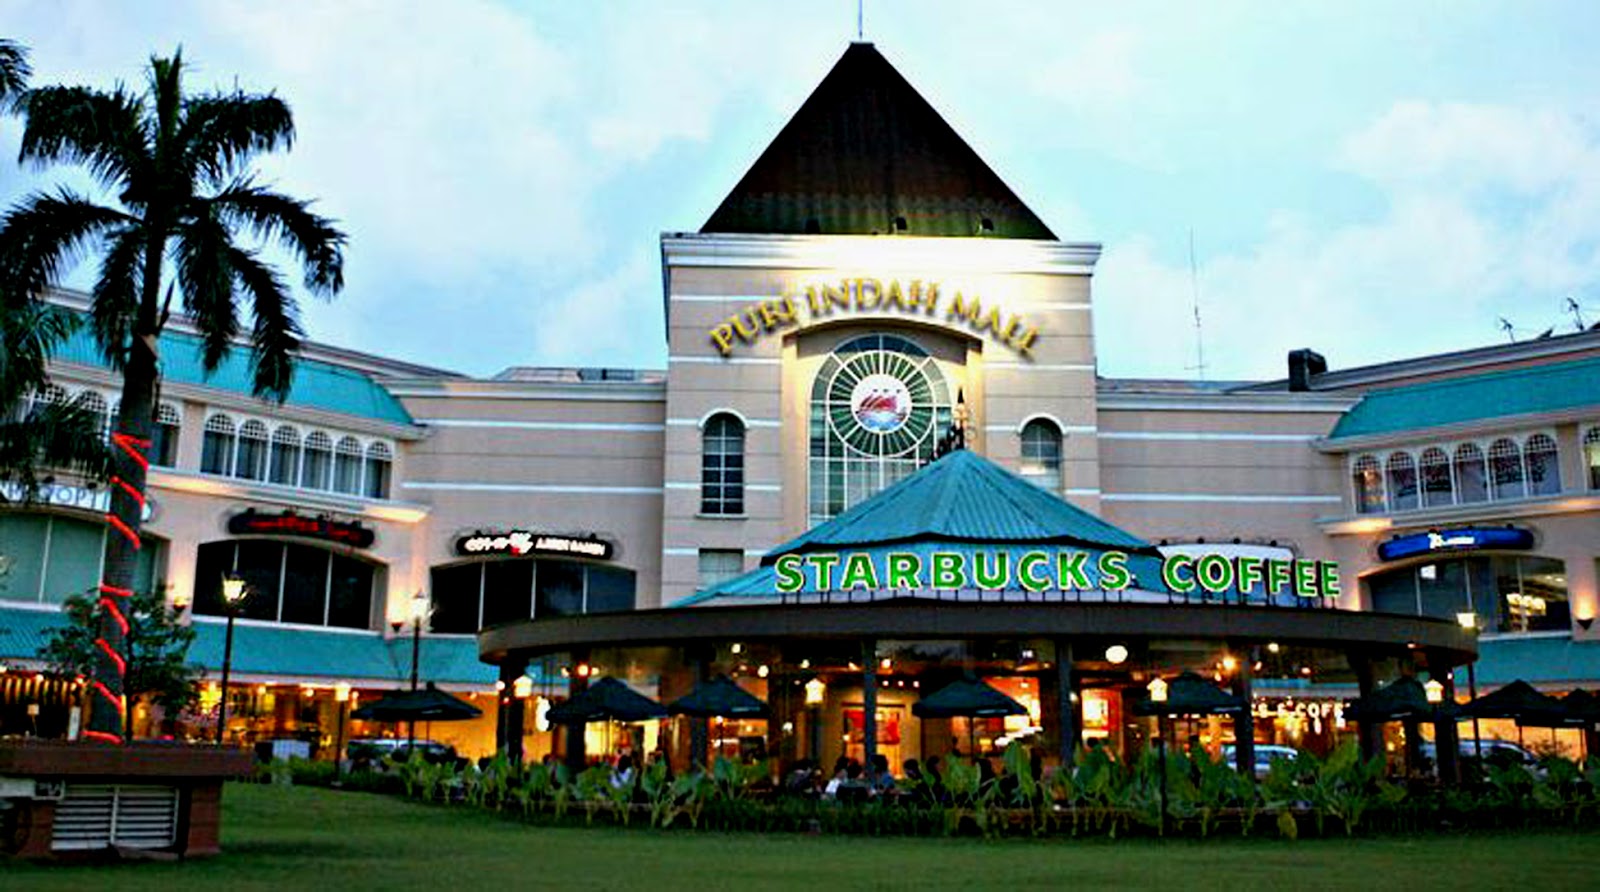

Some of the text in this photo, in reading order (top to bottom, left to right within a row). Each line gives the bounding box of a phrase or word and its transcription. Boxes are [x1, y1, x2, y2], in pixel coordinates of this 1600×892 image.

[709, 278, 1039, 354] PURI INDAH MALL
[774, 551, 1341, 597] STARBUCKS COFFEE
